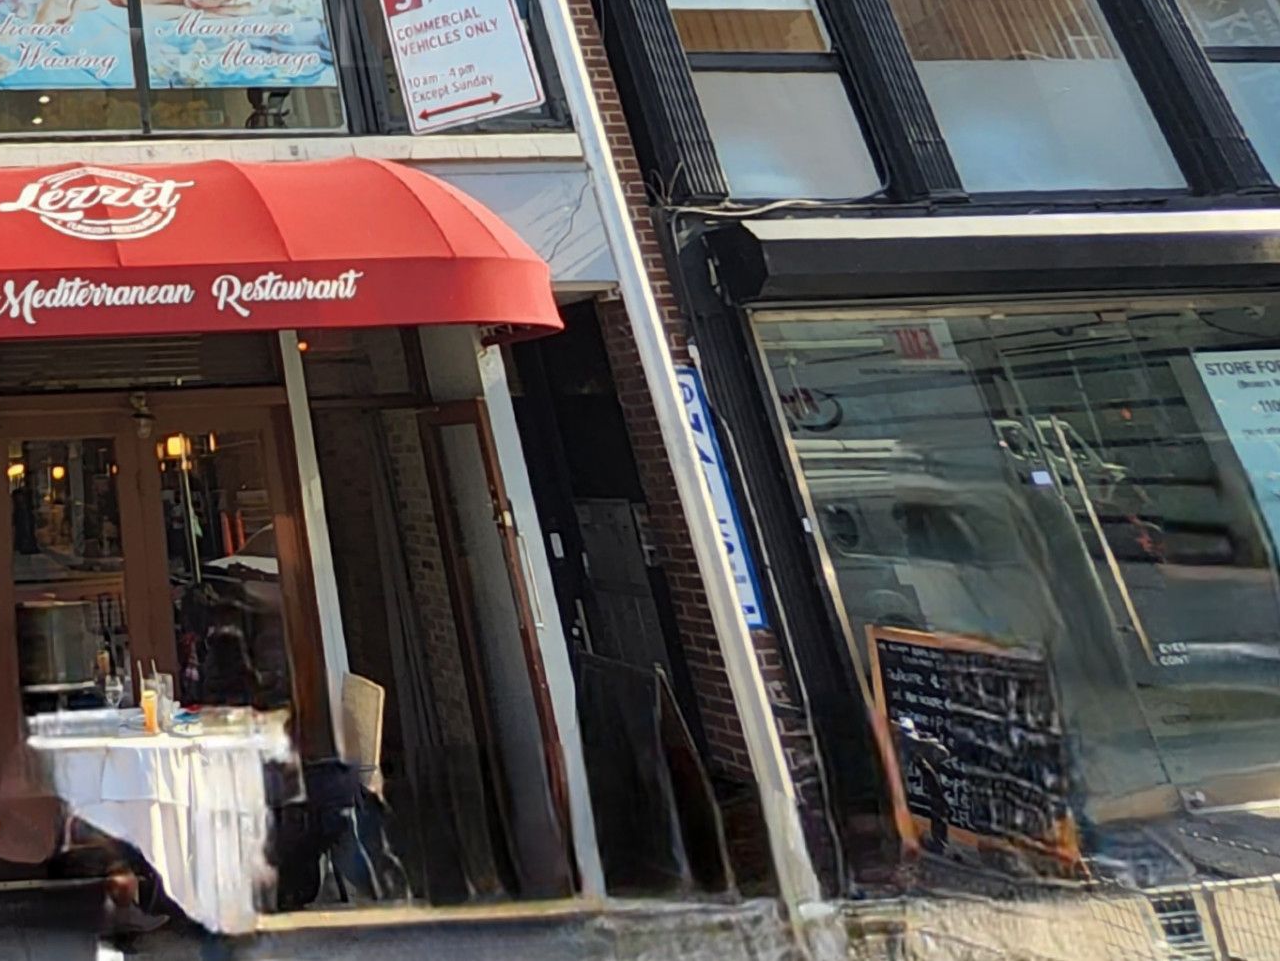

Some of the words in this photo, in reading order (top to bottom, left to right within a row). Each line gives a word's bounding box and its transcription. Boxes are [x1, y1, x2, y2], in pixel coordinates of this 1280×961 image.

[155, 10, 295, 36] Manicure
[396, 6, 481, 41] COMMERCIAL
[401, 29, 461, 56] VEHICLES
[465, 18, 498, 38] ONLY
[412, 85, 448, 103] Except
[452, 75, 494, 93] Sunday
[212, 270, 364, 317] Restaurant
[1205, 361, 1256, 376] STORE
[1256, 360, 1280, 374] FO
